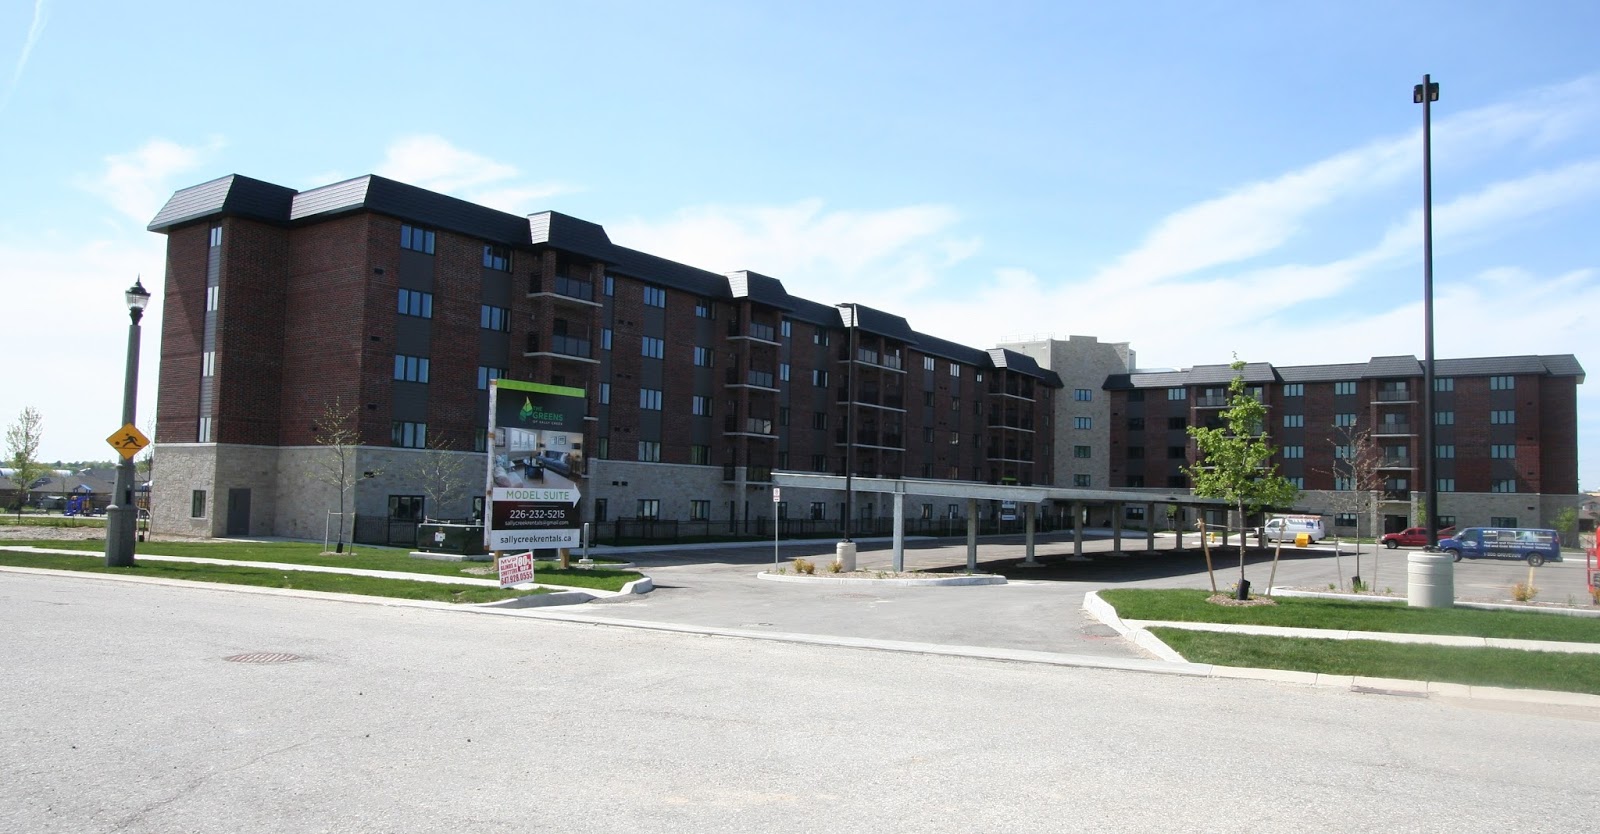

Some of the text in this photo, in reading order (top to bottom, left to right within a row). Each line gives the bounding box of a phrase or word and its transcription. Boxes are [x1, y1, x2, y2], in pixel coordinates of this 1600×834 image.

[533, 412, 563, 420] GREENS
[506, 490, 569, 500] MODEL SUITE
[510, 509, 565, 519] 226-232-5215
[500, 535, 571, 544] sallycreekrentals.ca
